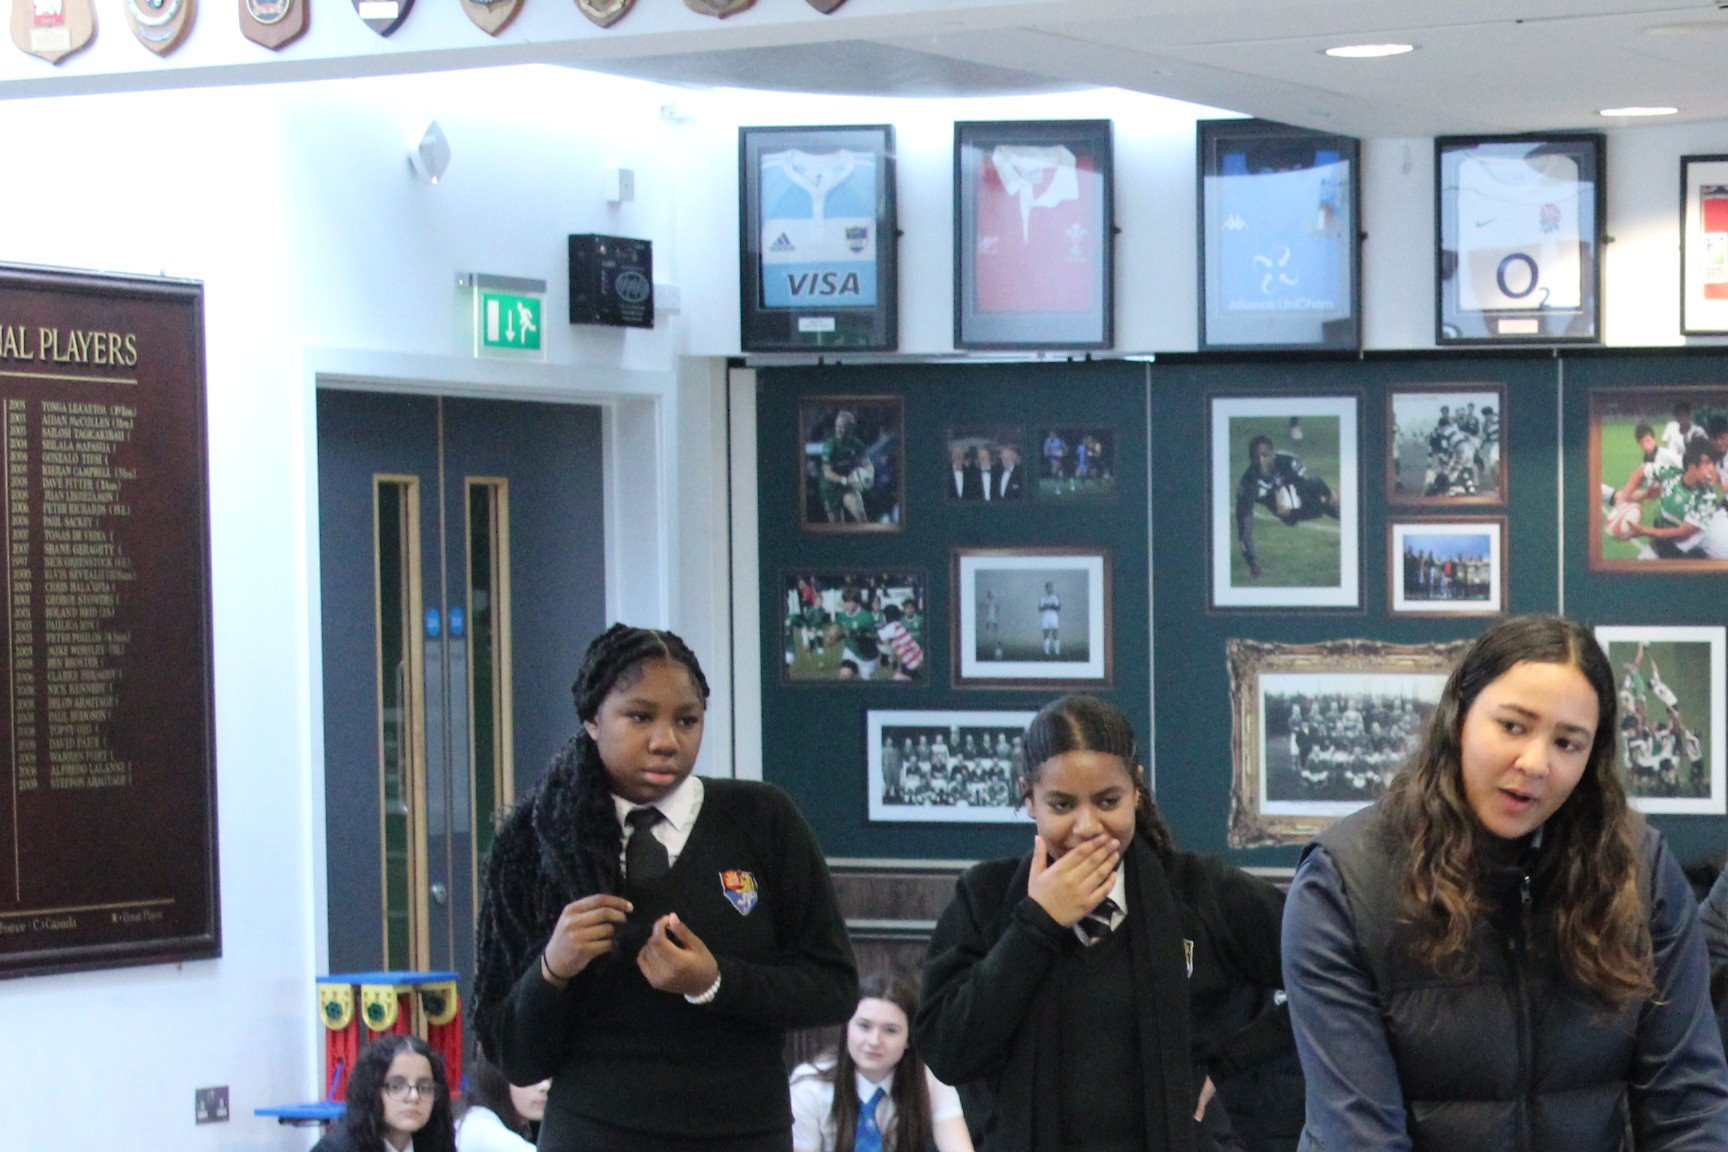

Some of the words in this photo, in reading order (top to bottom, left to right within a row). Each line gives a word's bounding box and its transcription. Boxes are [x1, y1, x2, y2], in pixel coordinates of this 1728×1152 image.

[787, 271, 861, 296] VISA
[0, 324, 34, 359] AL
[39, 327, 138, 366] PLAYERS
